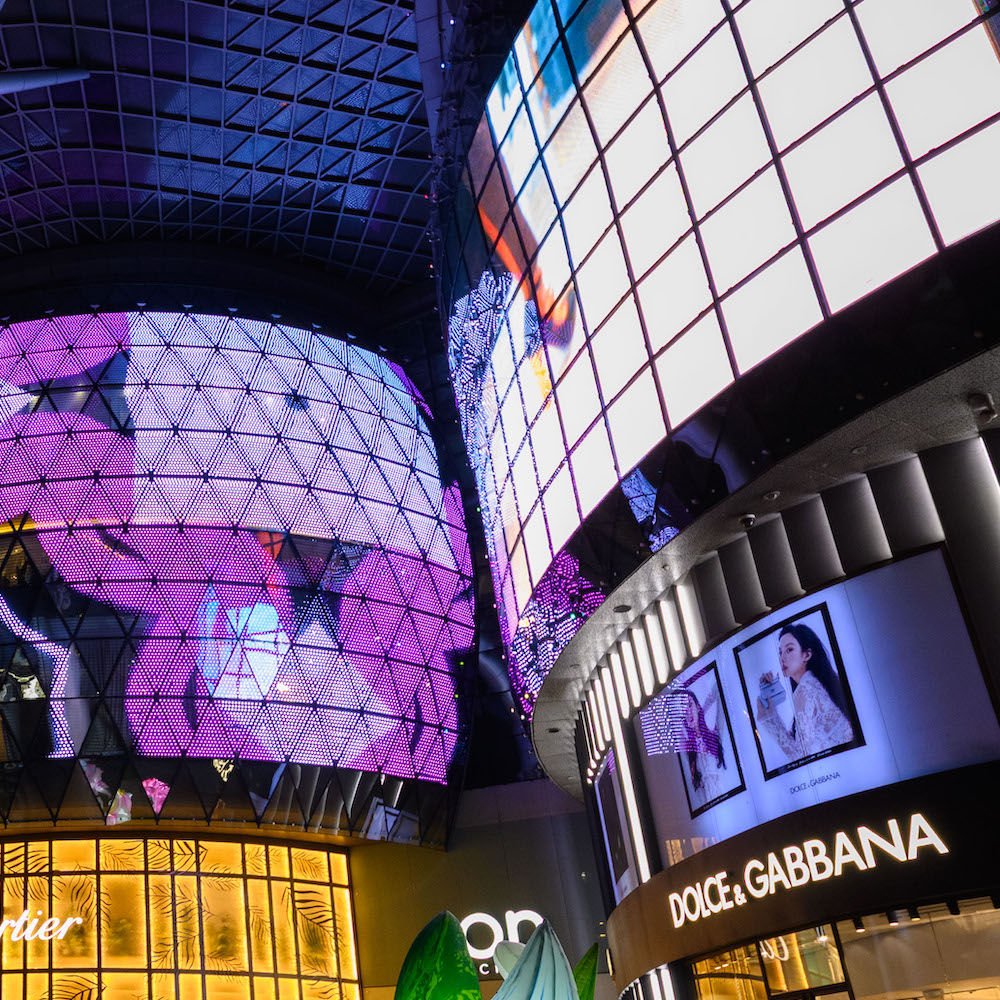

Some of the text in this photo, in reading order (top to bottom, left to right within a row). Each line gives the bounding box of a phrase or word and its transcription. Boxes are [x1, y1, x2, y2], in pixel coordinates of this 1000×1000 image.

[668, 813, 950, 929] DOLCE & GABBANA
